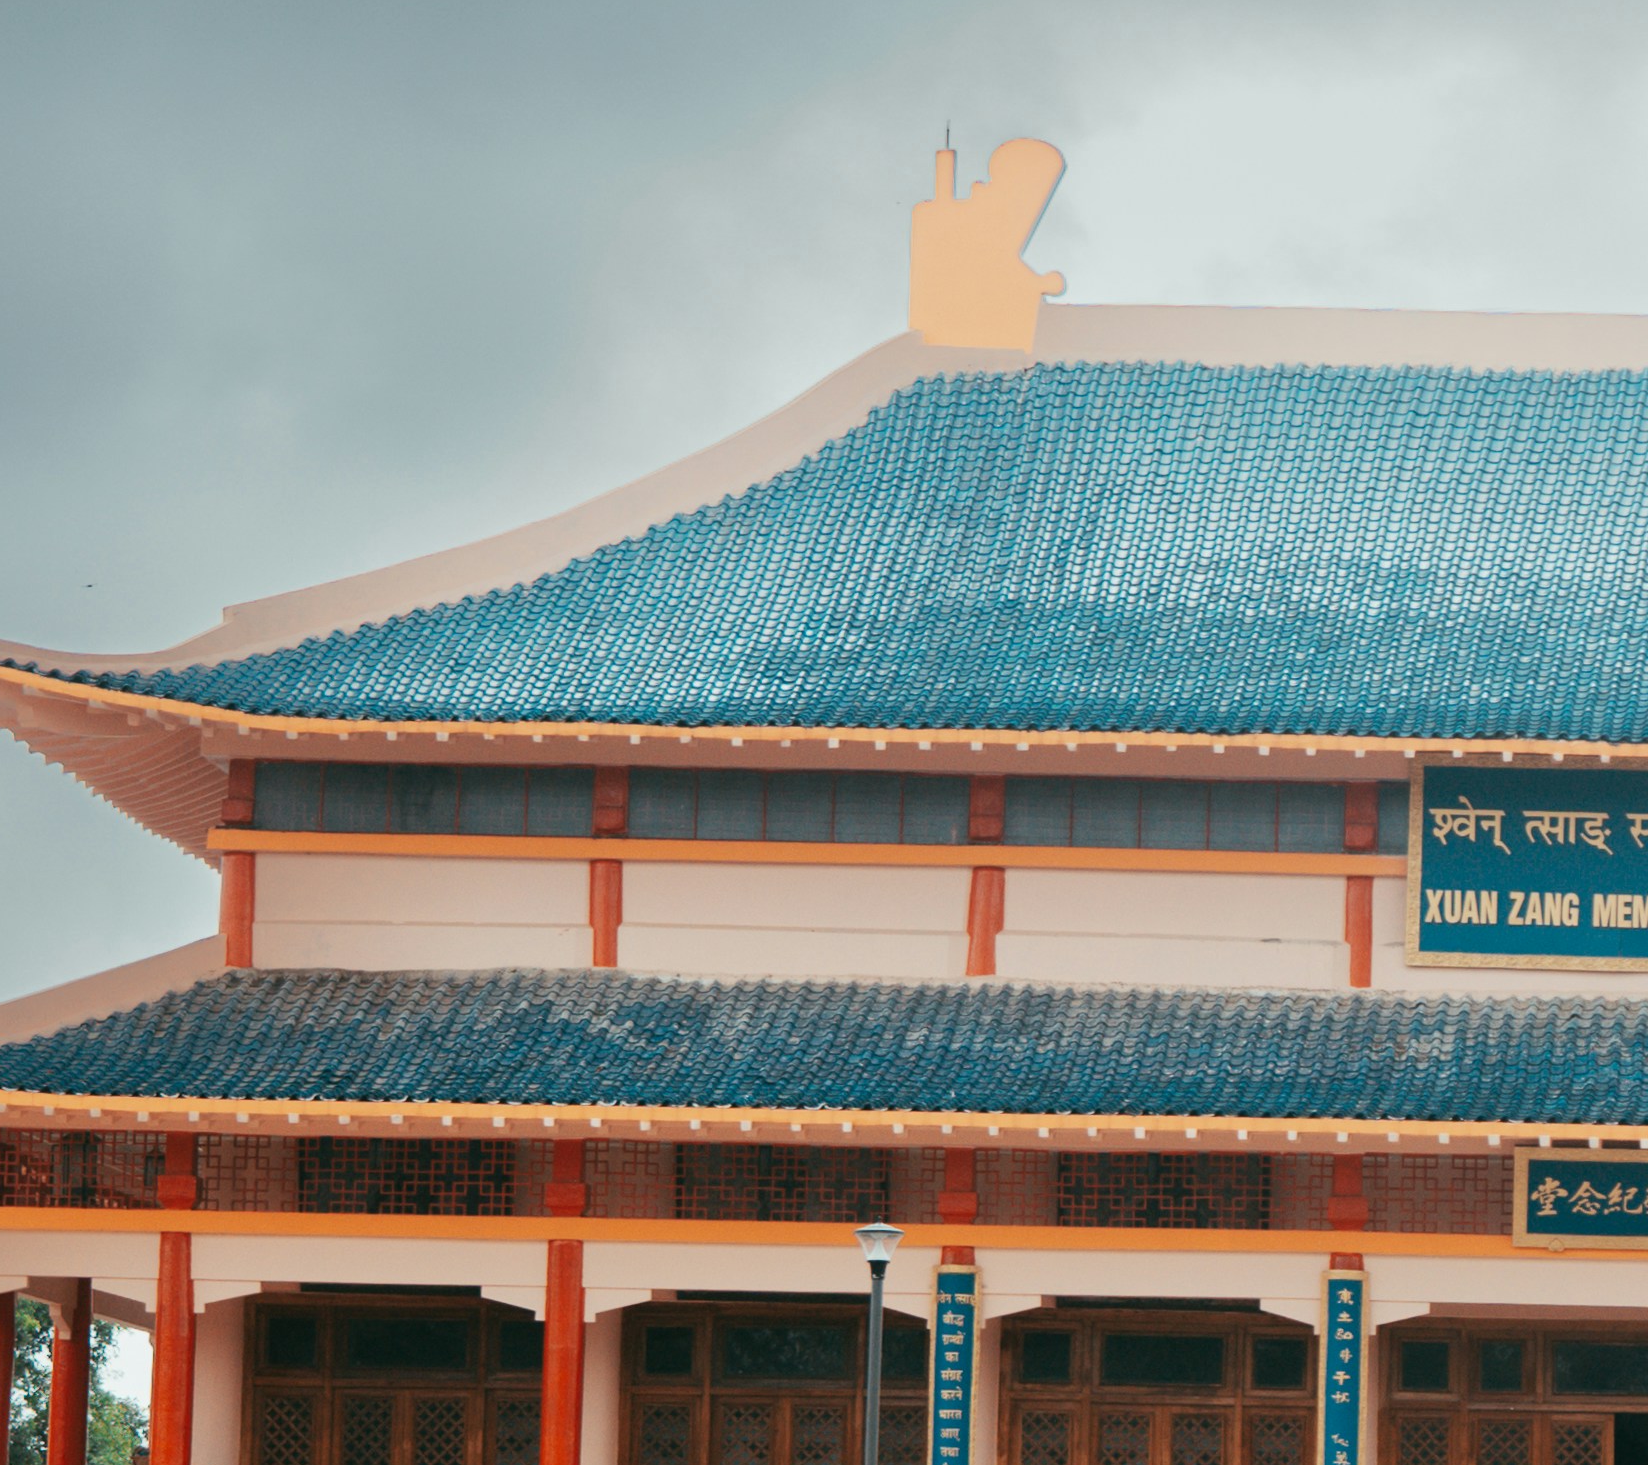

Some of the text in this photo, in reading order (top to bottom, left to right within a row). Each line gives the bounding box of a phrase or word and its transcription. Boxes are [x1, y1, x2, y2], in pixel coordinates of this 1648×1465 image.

[1425, 889, 1498, 924] XUAN
[1508, 891, 1579, 926] ZANG
[945, 1351, 959, 1363] का
[939, 1409, 962, 1420] भारत
[940, 1447, 959, 1457] तथा
